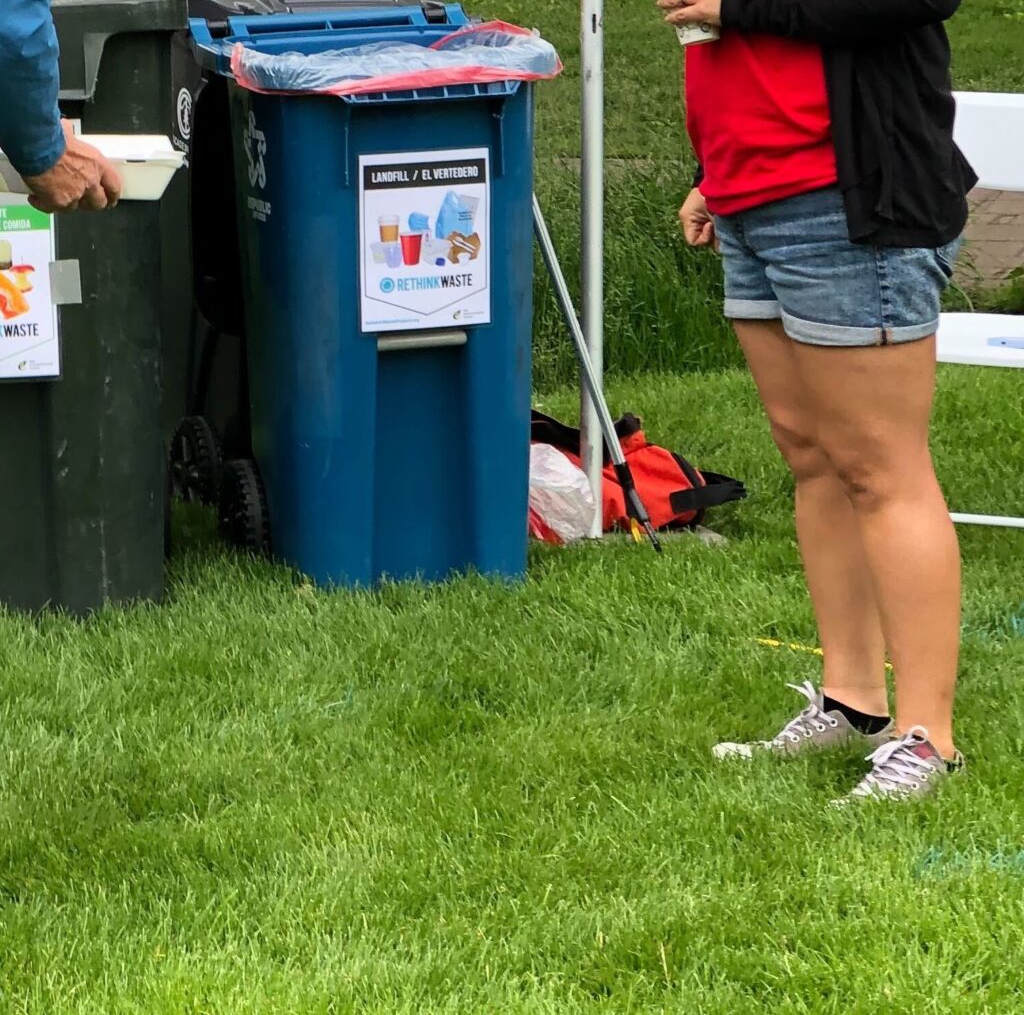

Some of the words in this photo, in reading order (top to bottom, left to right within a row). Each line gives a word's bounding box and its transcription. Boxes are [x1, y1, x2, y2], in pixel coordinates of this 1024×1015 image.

[371, 170, 409, 184] LANDFILL
[421, 169, 432, 181] EL
[433, 166, 479, 180] VERTEDERO
[2, 218, 32, 231] COMIDA
